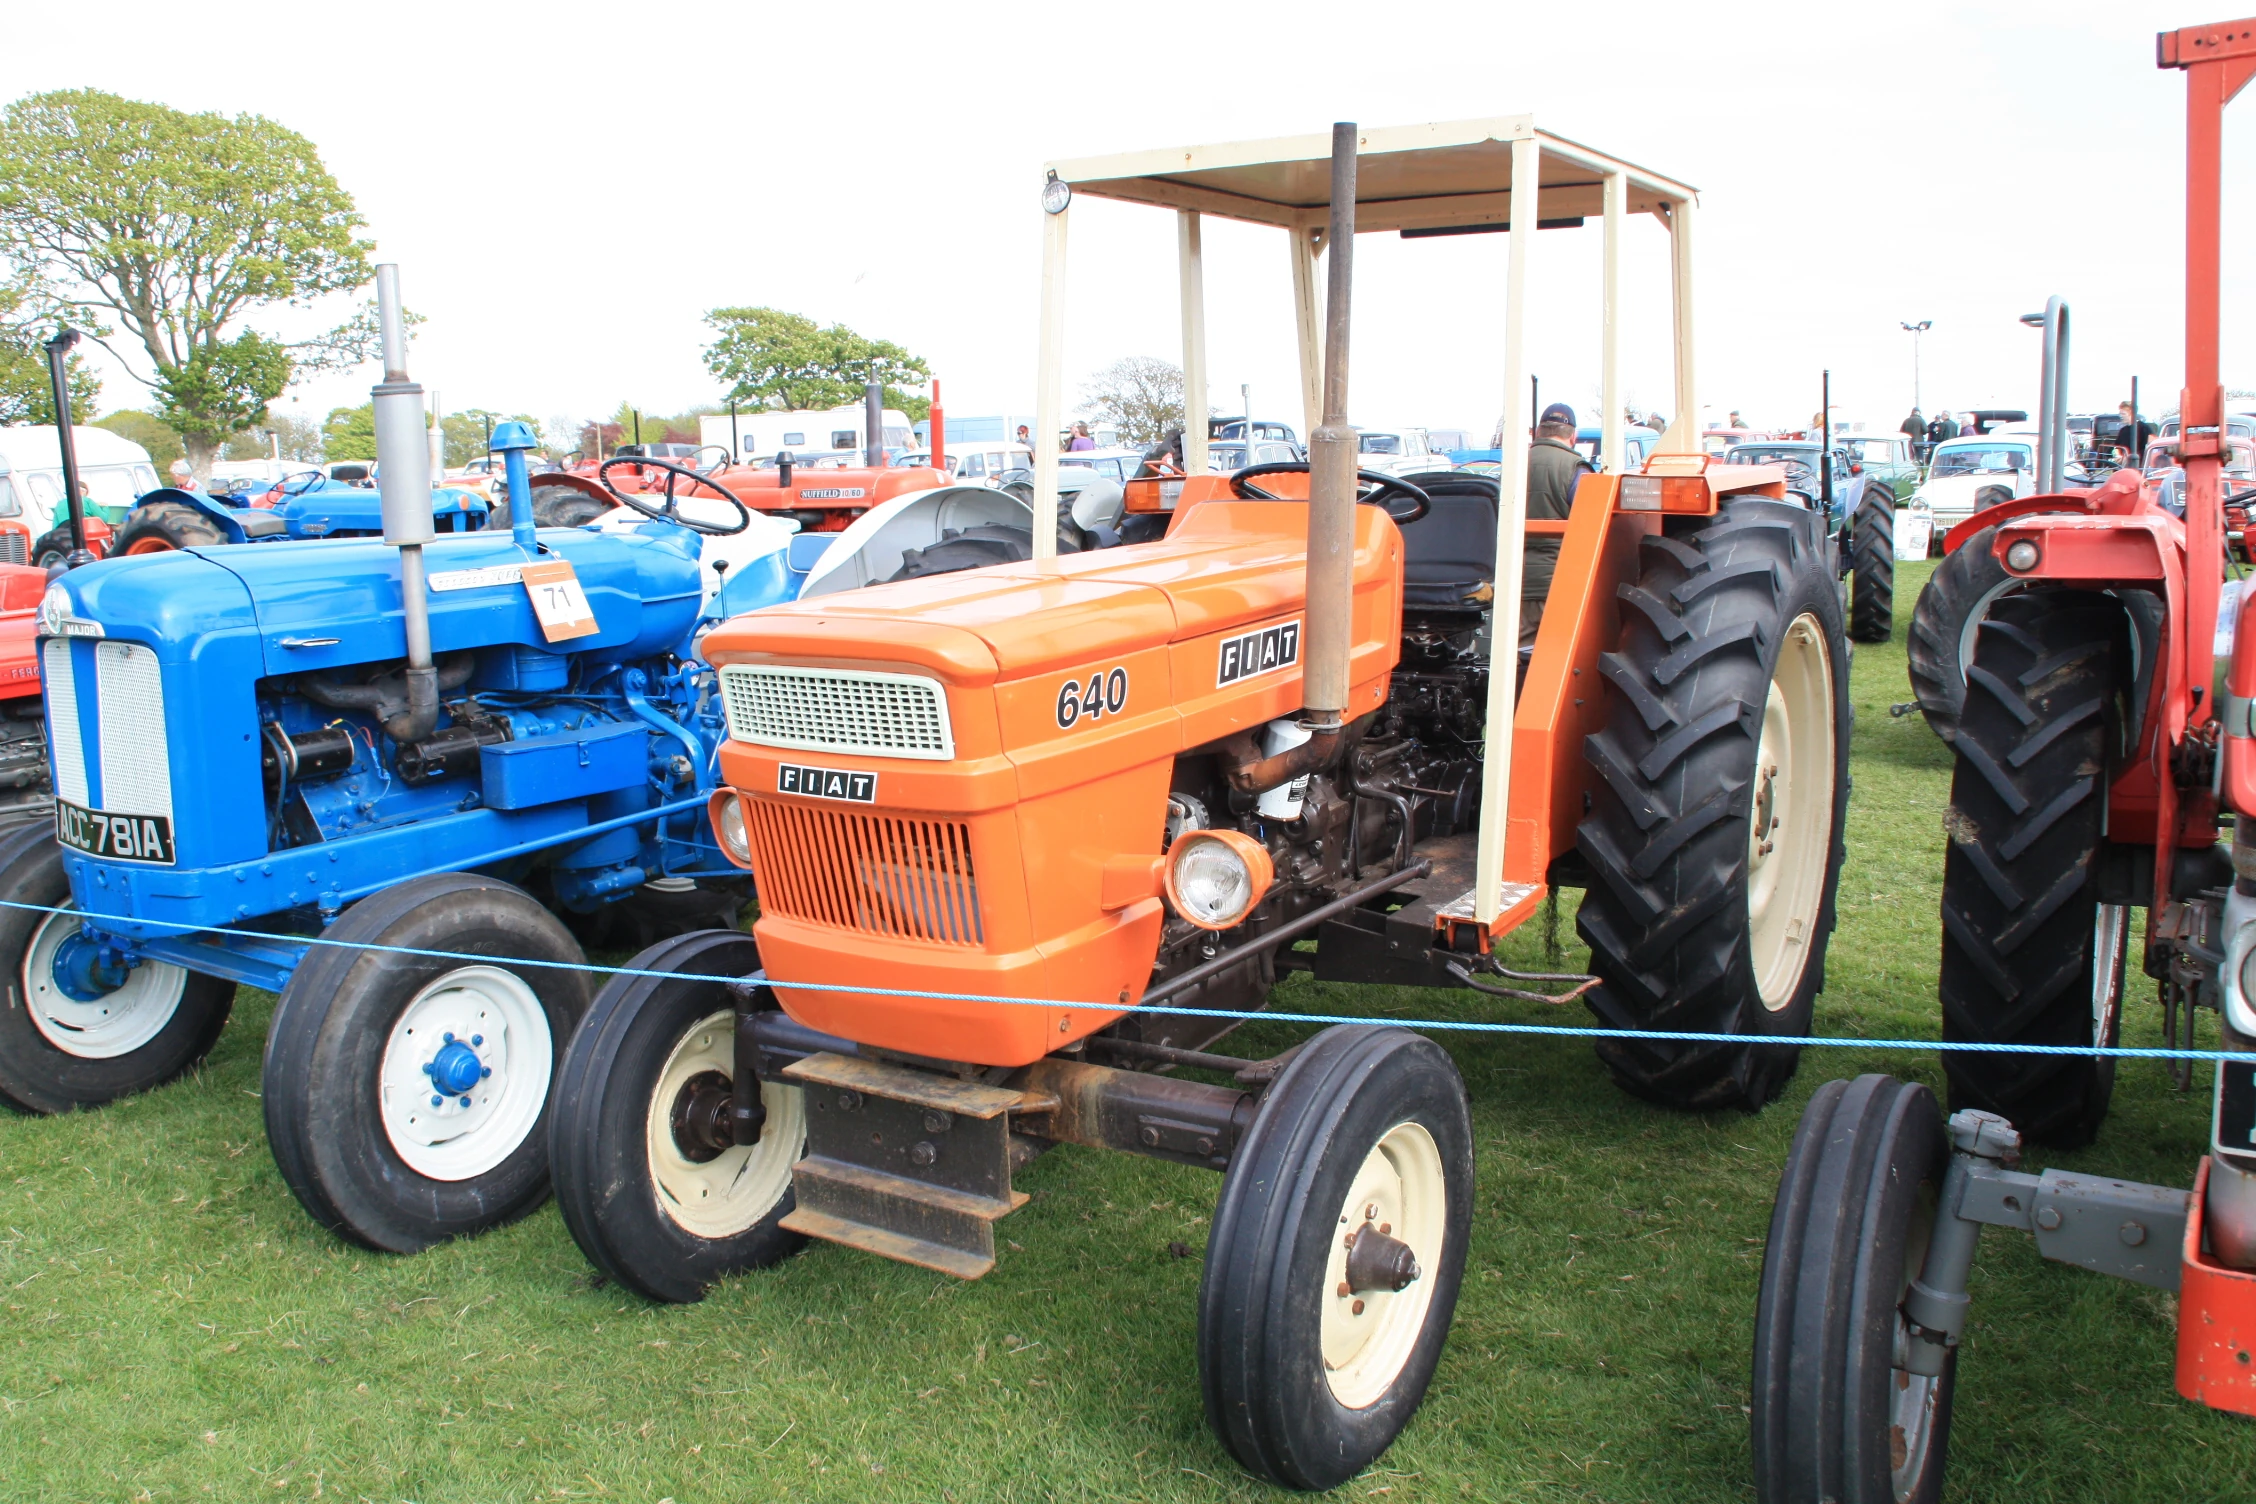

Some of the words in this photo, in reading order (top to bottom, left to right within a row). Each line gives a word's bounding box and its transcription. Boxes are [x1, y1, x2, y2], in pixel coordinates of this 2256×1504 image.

[802, 489, 838, 498] NUFFIELD
[543, 585, 572, 610] 71
[66, 624, 97, 636] MAJOR
[1224, 630, 1295, 677] FIAT
[1057, 667, 1127, 728] 640
[783, 768, 870, 798] FIAT
[60, 803, 91, 849] ACC
[91, 814, 165, 859] 781A
